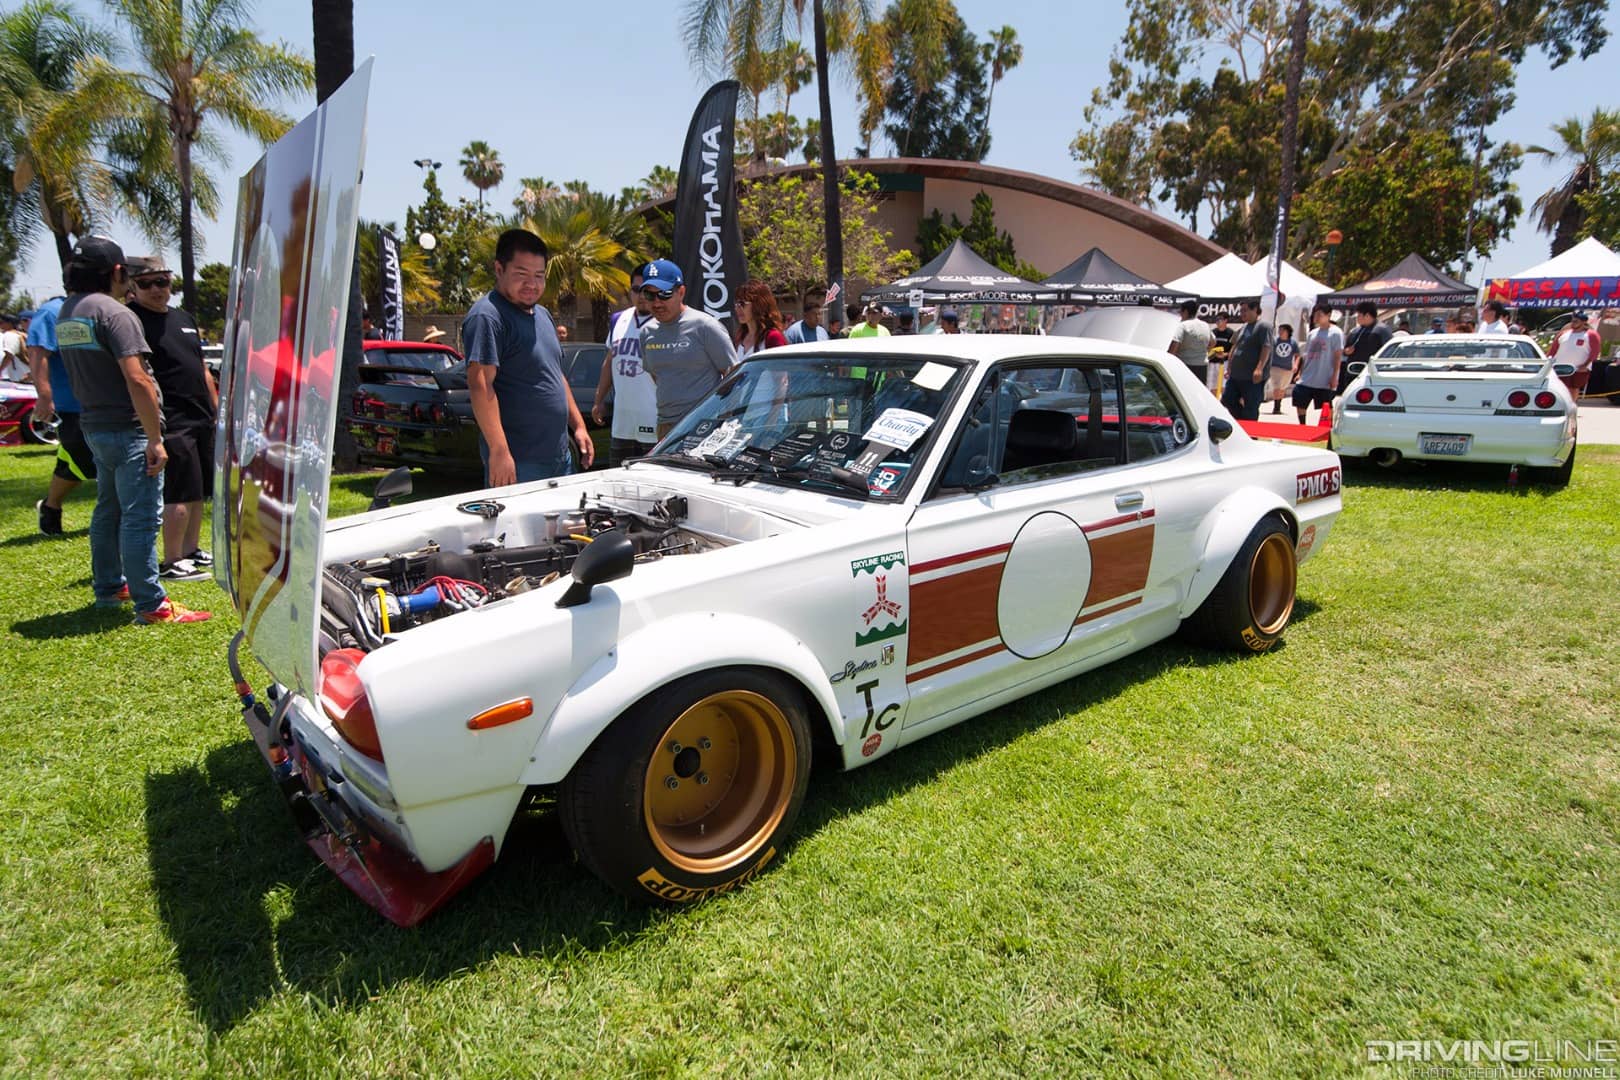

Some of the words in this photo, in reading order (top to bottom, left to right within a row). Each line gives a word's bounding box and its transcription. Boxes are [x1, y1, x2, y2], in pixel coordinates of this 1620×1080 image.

[699, 124, 732, 322] YOKOHAMA
[1011, 293, 1033, 301] CARS
[1488, 280, 1602, 299] NISSAN
[1198, 303, 1241, 318] OHAM
[611, 338, 642, 358] SUN
[619, 359, 637, 377] 13
[880, 419, 919, 436] Charity
[852, 559, 879, 570] SKYLINE
[880, 552, 904, 563] RACING
